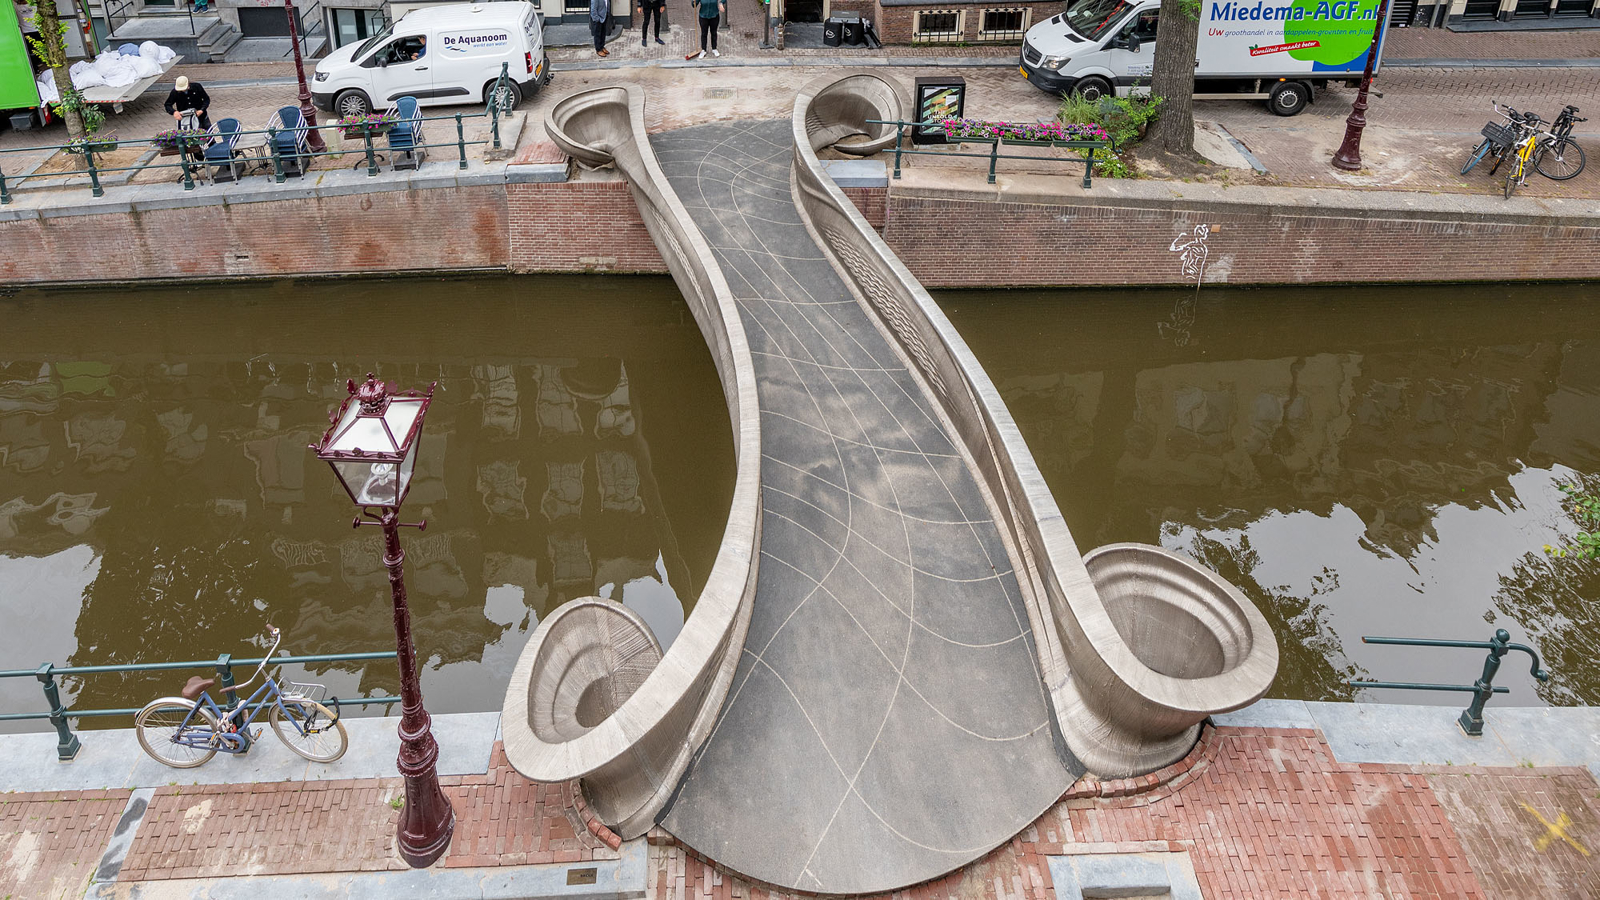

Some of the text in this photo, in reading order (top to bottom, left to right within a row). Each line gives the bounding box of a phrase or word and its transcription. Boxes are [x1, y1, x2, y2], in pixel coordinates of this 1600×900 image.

[1210, 1, 1379, 20] Miedema-AGF.nl
[1208, 28, 1224, 36] Uw
[1225, 29, 1265, 37] groothandel
[458, 34, 507, 45] Aquanoom
[1252, 47, 1278, 55] Kwaliteit
